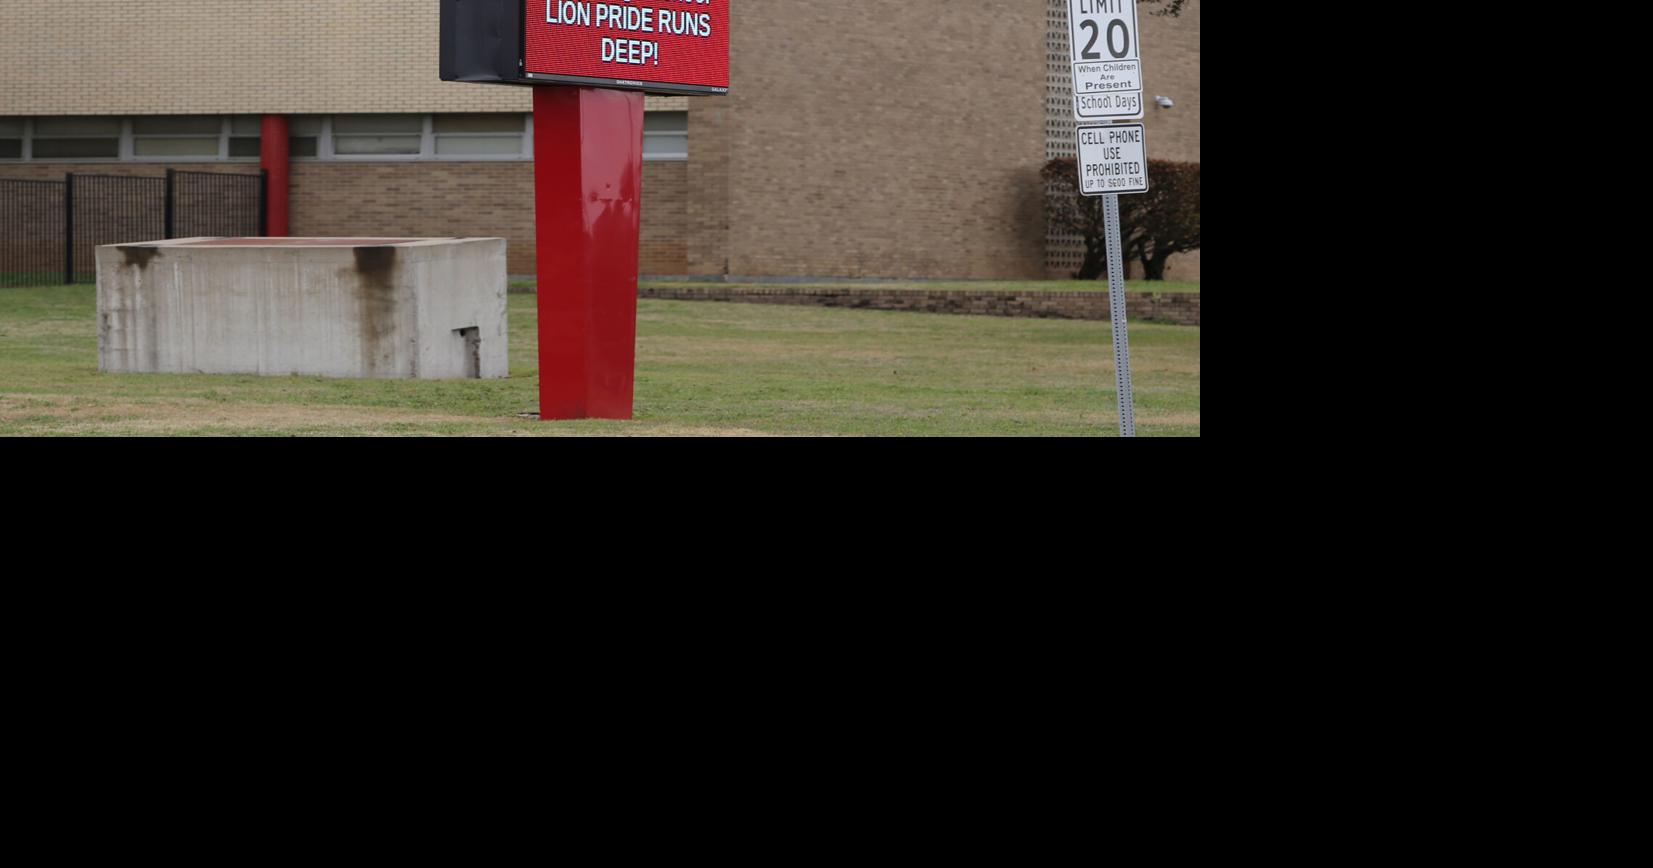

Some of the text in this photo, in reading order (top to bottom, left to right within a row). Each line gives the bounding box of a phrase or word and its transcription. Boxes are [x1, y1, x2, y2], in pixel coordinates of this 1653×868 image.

[1080, 0, 1122, 14] LIMIT
[546, 0, 711, 37] LION PRIDE RUNS
[1079, 18, 1130, 60] 20
[601, 37, 659, 66] DEEP!
[1078, 63, 1136, 73] When Children
[1085, 80, 1132, 91] Present
[1081, 95, 1137, 110] School Days
[1081, 130, 1140, 145] CELL PHONE
[1103, 147, 1121, 160] USE
[1086, 161, 1140, 177] PROHIBITED
[1085, 179, 1094, 189] UP
[1096, 178, 1105, 188] TO
[1128, 176, 1143, 186] FINE
